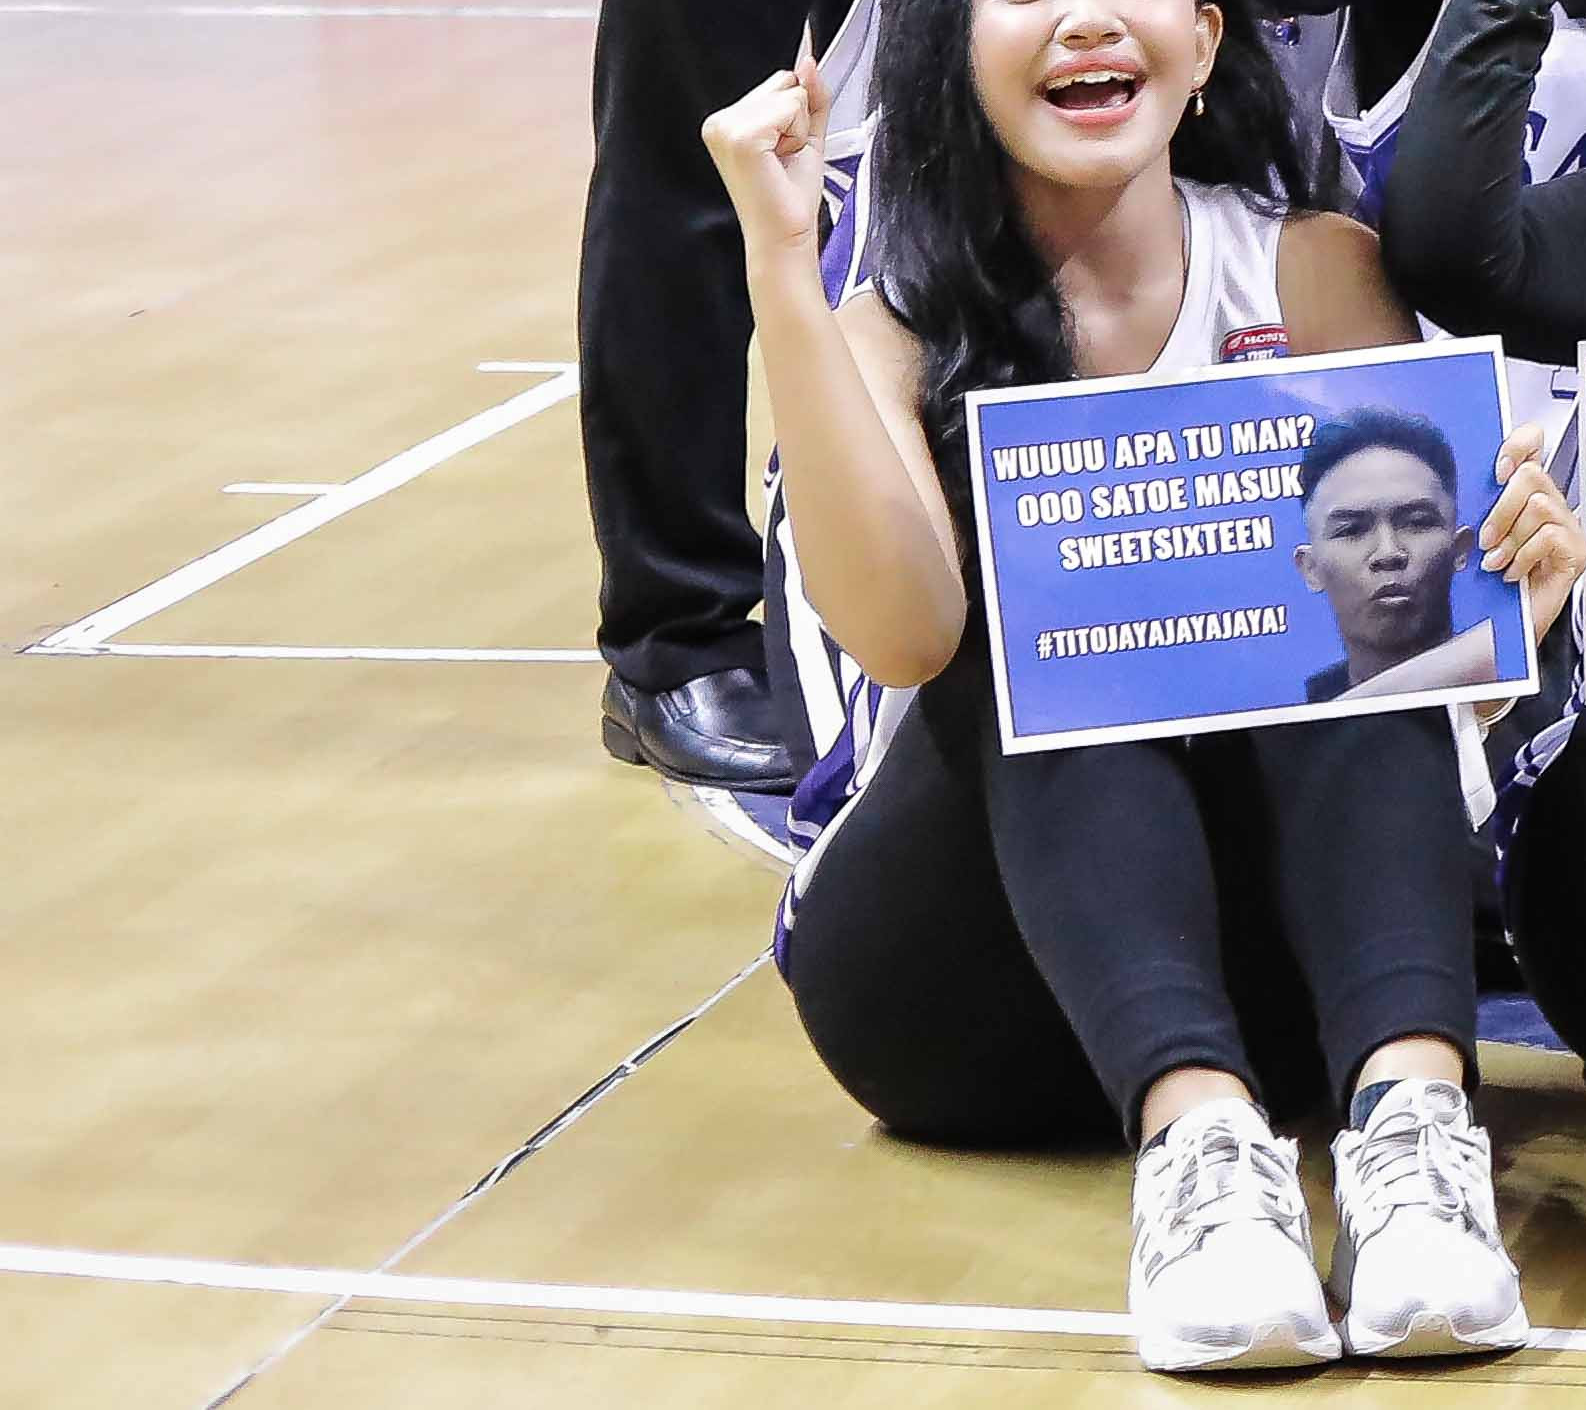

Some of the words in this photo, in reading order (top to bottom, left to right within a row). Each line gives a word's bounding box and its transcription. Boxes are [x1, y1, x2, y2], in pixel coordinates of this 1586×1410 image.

[991, 439, 1105, 482] WUUUU
[1113, 431, 1176, 469] APA
[1181, 425, 1223, 460] TU
[1230, 413, 1316, 456] MAN?
[1090, 478, 1189, 522] SATOE
[1194, 463, 1305, 509] MASUK
[1059, 515, 1274, 573] SWEETSIXTEEN
[1036, 605, 1287, 661] #TITOJAYAJAYAJAYA!
